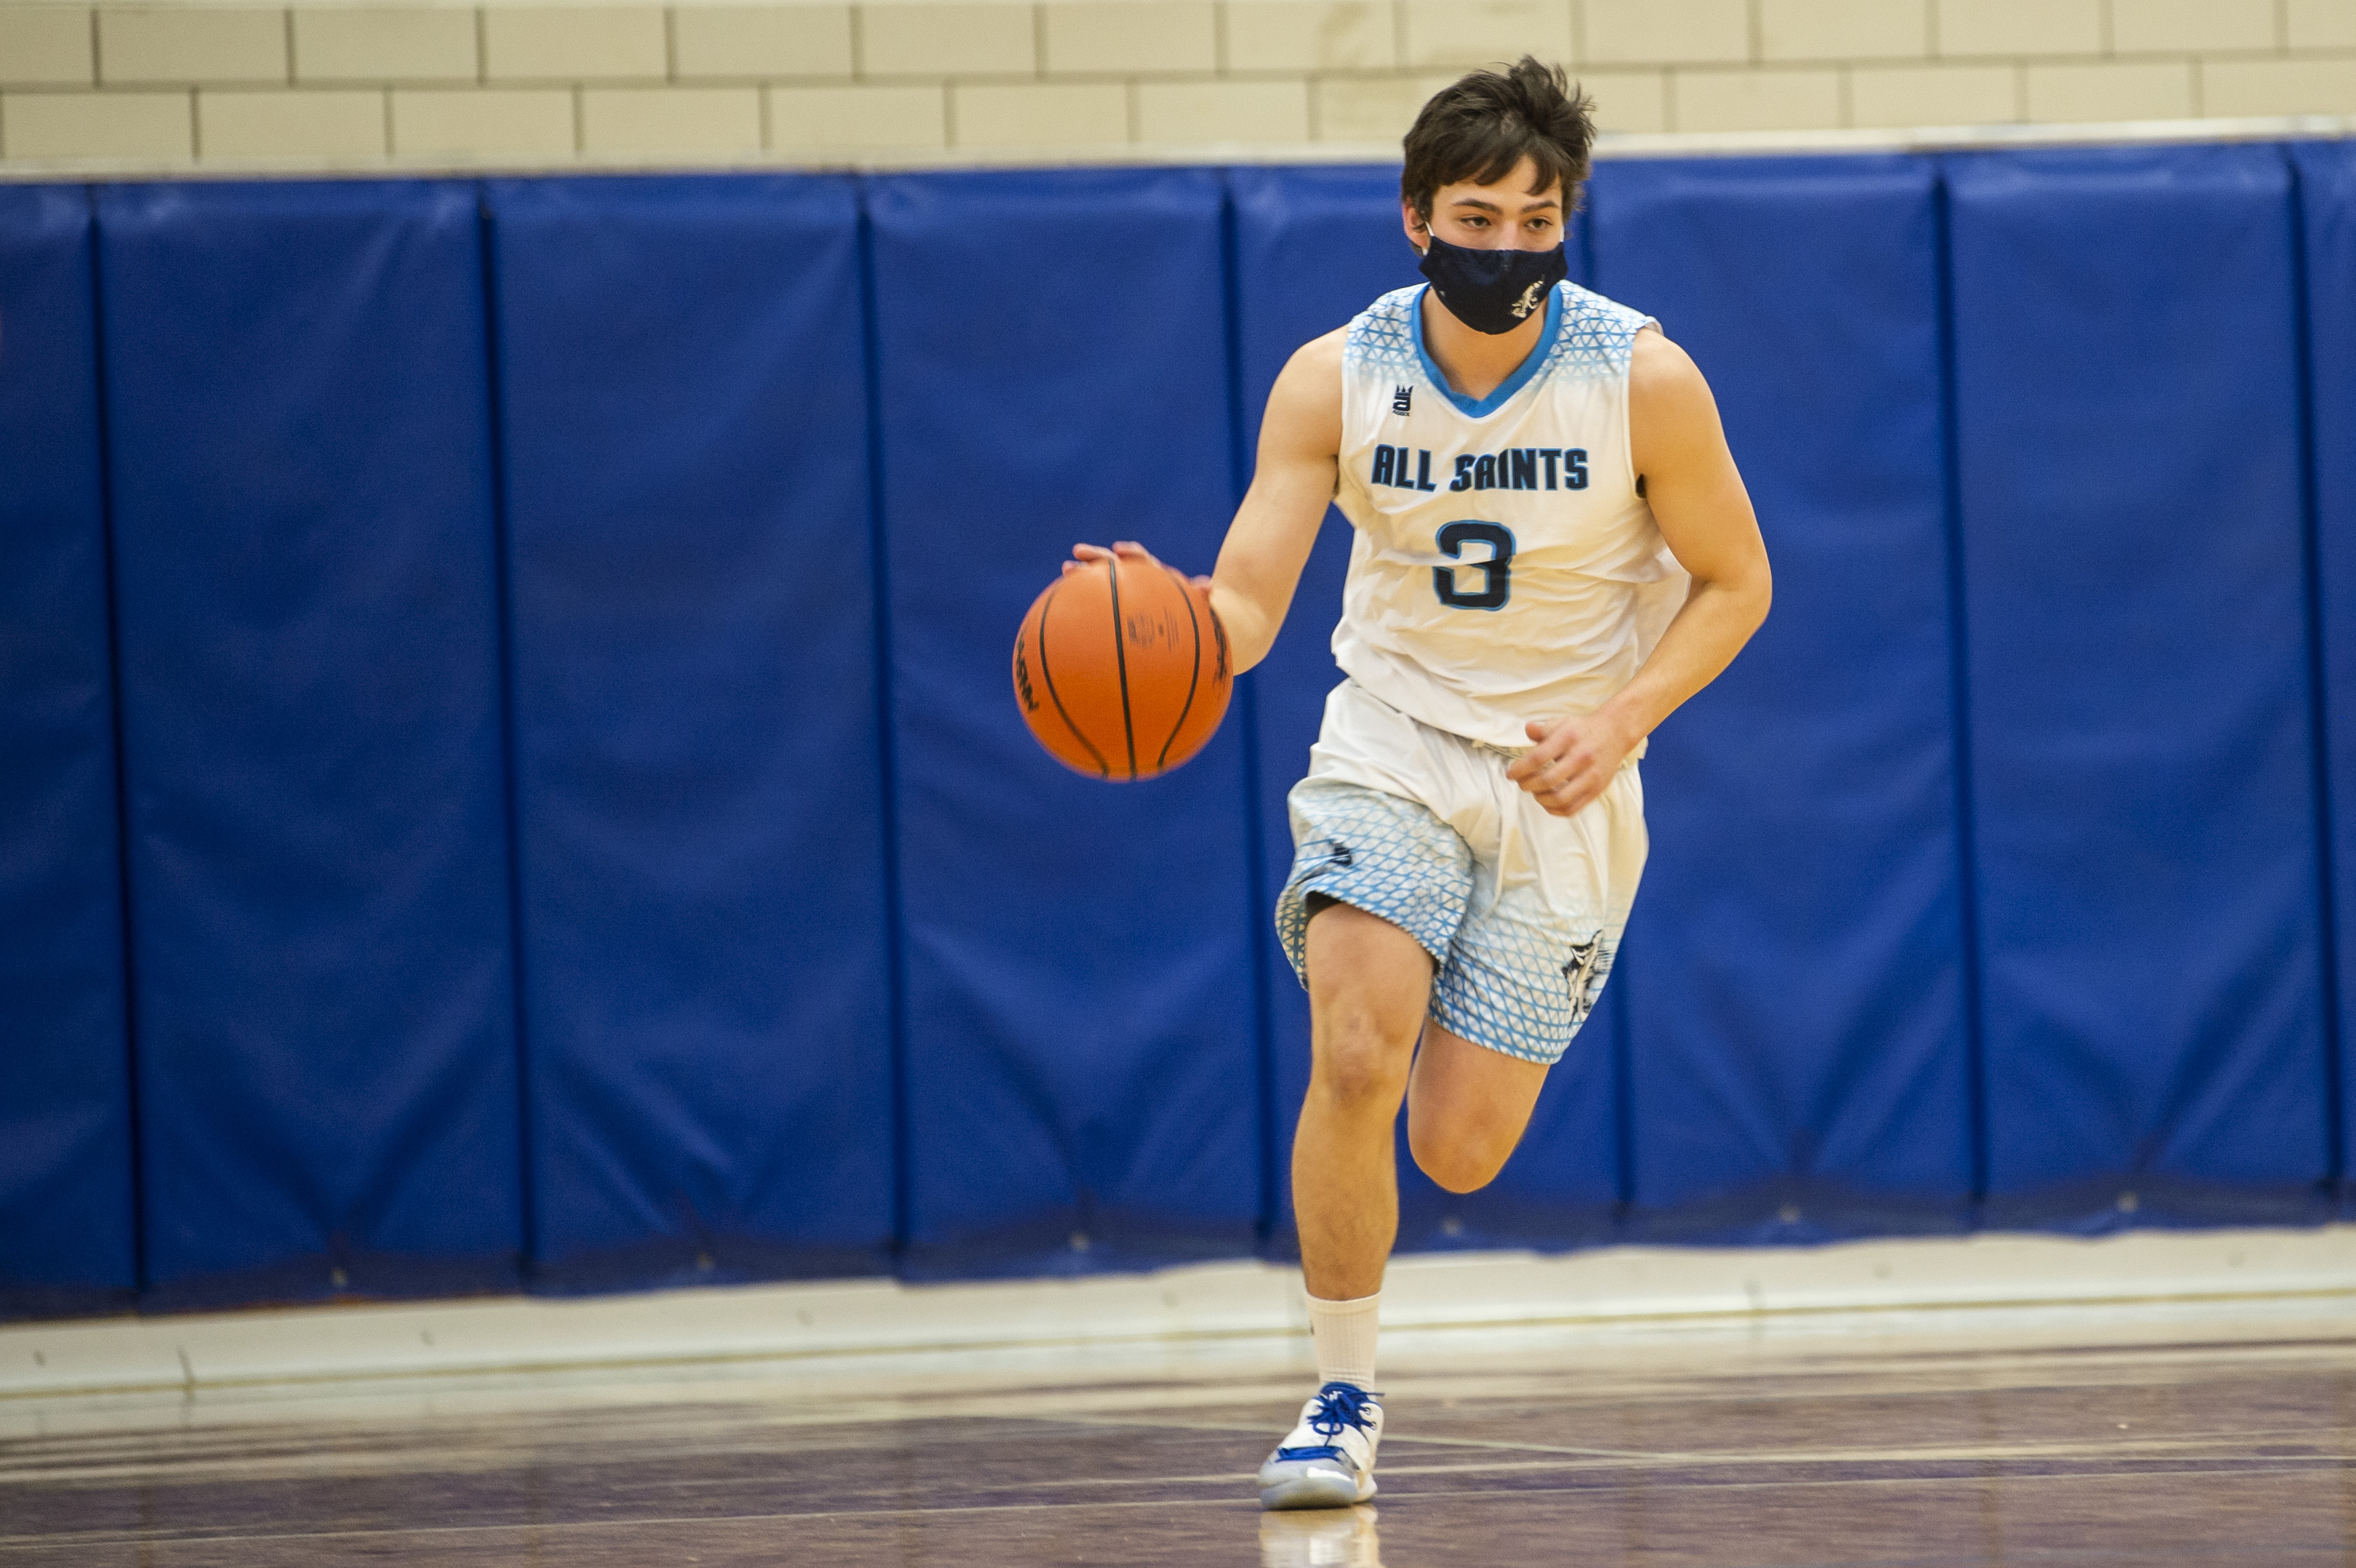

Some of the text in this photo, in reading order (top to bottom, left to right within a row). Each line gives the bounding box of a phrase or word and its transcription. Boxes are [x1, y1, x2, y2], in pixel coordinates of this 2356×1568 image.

[1371, 444, 1589, 492] ALL SAINTS
[1433, 520, 1516, 611] 3
